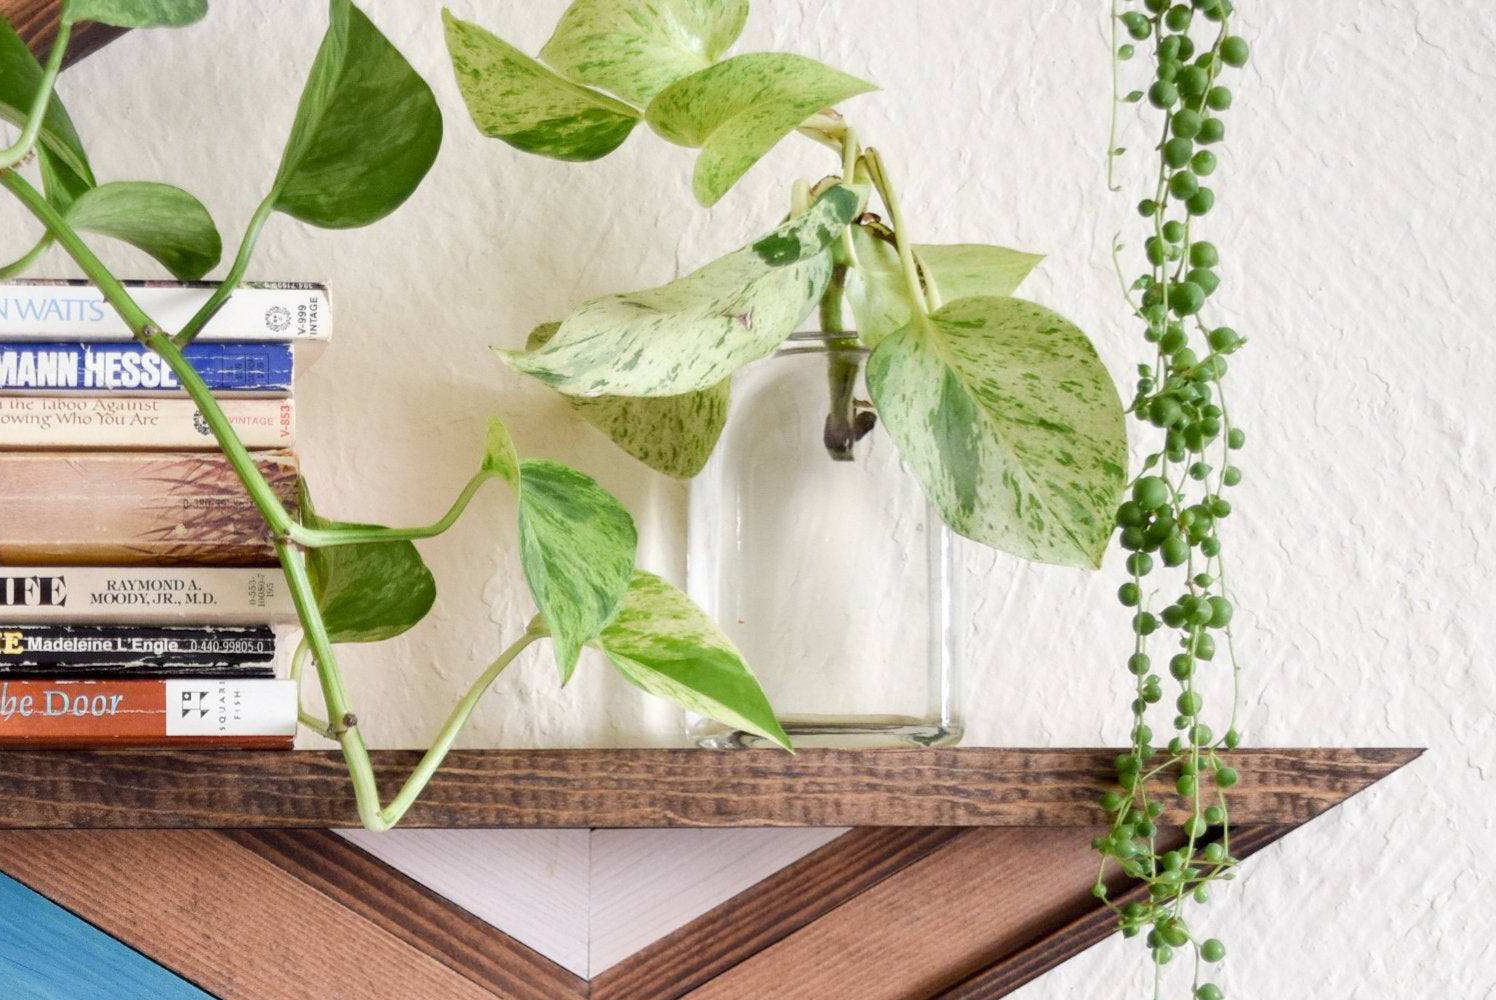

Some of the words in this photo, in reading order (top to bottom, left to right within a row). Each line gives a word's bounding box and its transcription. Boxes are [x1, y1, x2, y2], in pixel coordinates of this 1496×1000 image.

[14, 298, 104, 323] WATTS
[297, 304, 307, 335] V-999
[309, 296, 319, 338] INTAGE
[92, 399, 159, 414] Against
[56, 412, 92, 425] Who
[96, 411, 125, 426] You
[129, 412, 159, 426] Are
[228, 416, 274, 426] VINTAGE
[280, 404, 290, 438] V-853
[106, 579, 185, 591] RAYMOND
[187, 579, 202, 591] A.
[90, 593, 150, 605] MOODY,
[152, 593, 182, 606] JR.,
[185, 592, 217, 605] M.D.
[27, 637, 112, 651] Madeleine
[190, 640, 264, 653] 0-440-99805-0
[43, 690, 124, 717] Door
[233, 690, 241, 720] FISH
